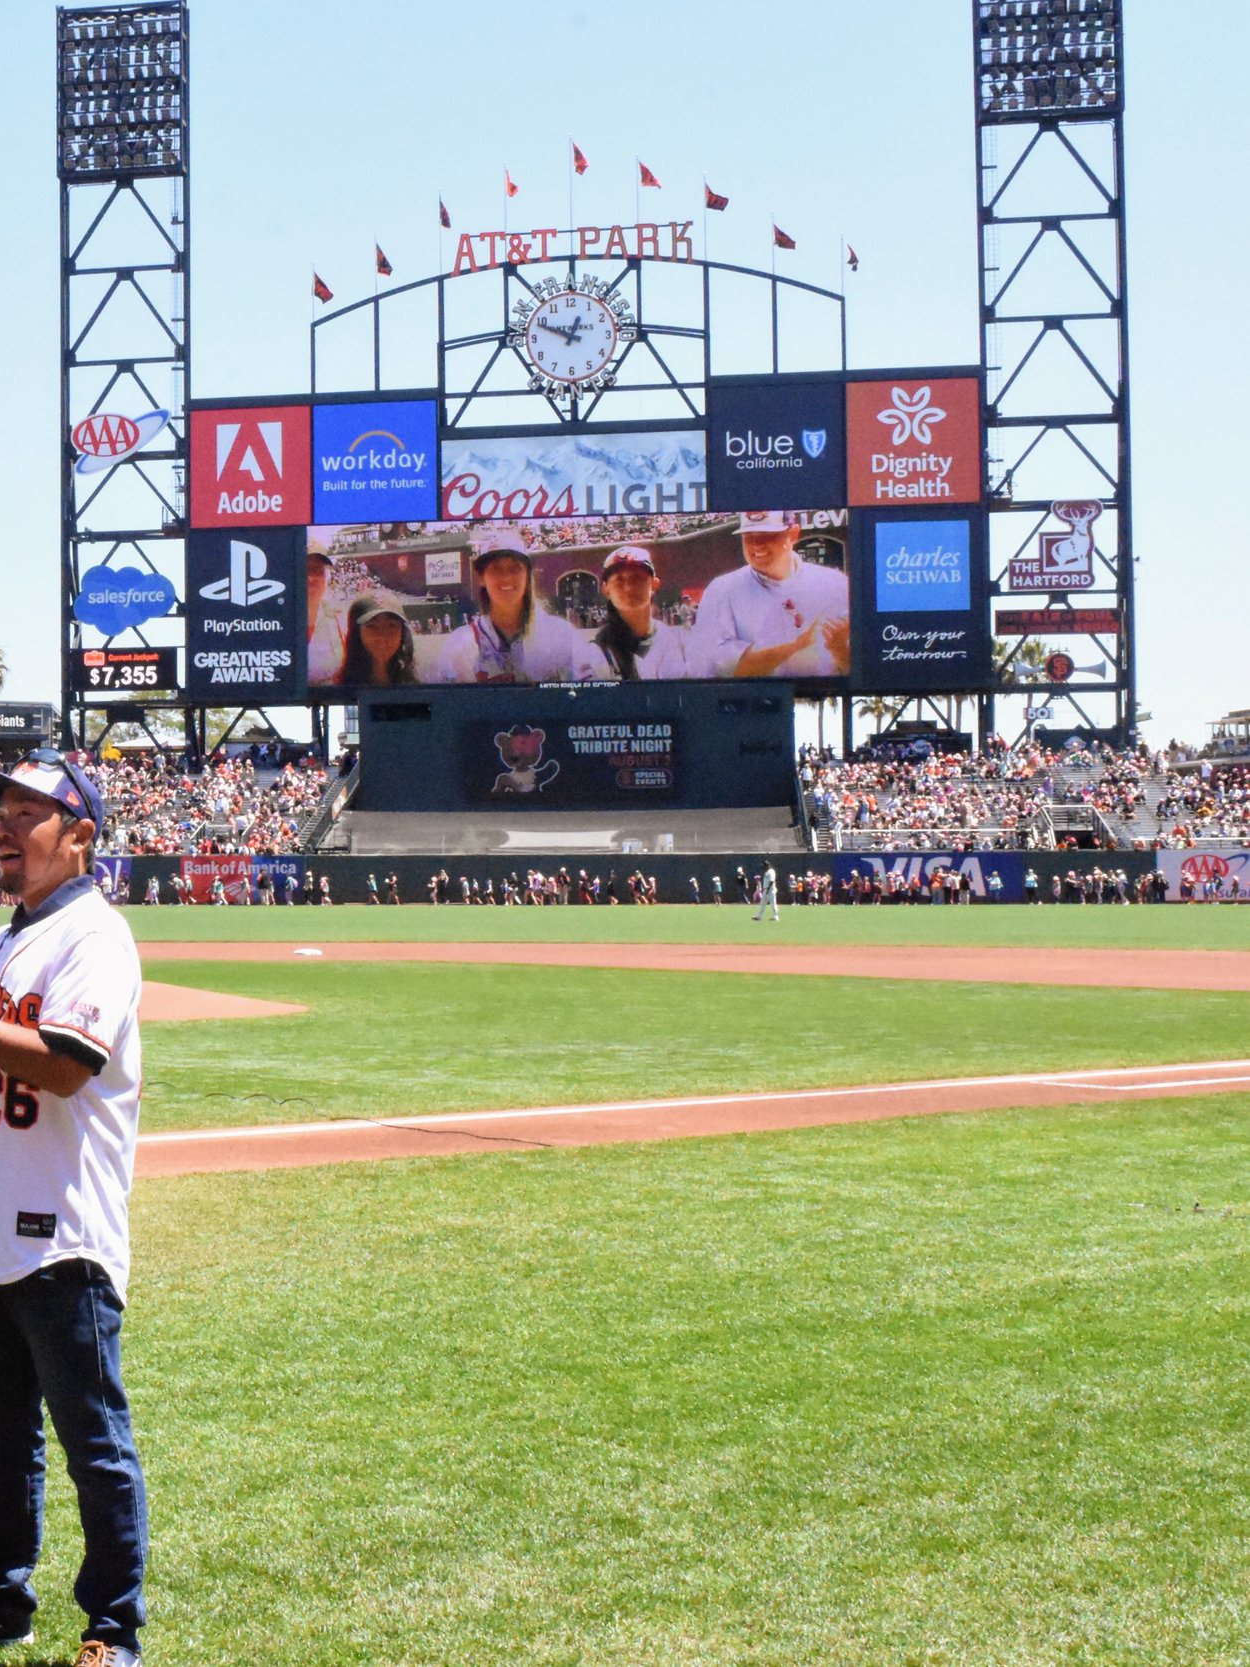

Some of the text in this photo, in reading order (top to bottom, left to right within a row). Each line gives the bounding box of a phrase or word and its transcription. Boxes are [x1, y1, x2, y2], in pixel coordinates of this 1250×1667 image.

[450, 221, 693, 277] AT&T PARK
[506, 273, 637, 347] SAN FRANCISCO
[549, 304, 558, 313] 11
[565, 298, 576, 307] 12
[586, 302, 592, 311] 1
[537, 317, 547, 327] 10
[598, 313, 605, 323] 2
[549, 323, 594, 332] MEWRKS
[605, 330, 611, 340] 3
[531, 334, 537, 344] 9
[537, 351, 544, 361] 8
[598, 348, 605, 358] 4
[551, 362, 558, 372] 7
[568, 367, 575, 376] 6
[586, 361, 592, 370] 5
[527, 368, 617, 400] GIANTS
[76, 414, 137, 456] AAA
[725, 430, 794, 457] blue
[321, 449, 425, 473] workday
[736, 456, 803, 470] california
[871, 453, 953, 478] Dignity
[323, 480, 348, 491] Built
[351, 479, 368, 490] for
[370, 479, 388, 490] the
[876, 477, 950, 498] Health
[217, 489, 283, 514] Adobe
[441, 473, 707, 520] Coors LIGHT
[800, 509, 848, 530] Lev
[886, 546, 961, 569] charles
[1013, 562, 1040, 573] THE
[885, 570, 961, 585] SCHWAB
[1013, 574, 1091, 587] HARTFORD
[87, 588, 165, 607] salesforce
[882, 624, 966, 649] Own your
[194, 650, 291, 668] GREATNESS
[89, 665, 158, 688] $7,355
[211, 667, 275, 684] AWAITS
[568, 724, 672, 739] GRATEFUL DEAD
[573, 739, 672, 753] TRIBUTE NIGHT
[183, 861, 297, 875] Bank of America
[860, 857, 987, 897] VISA
